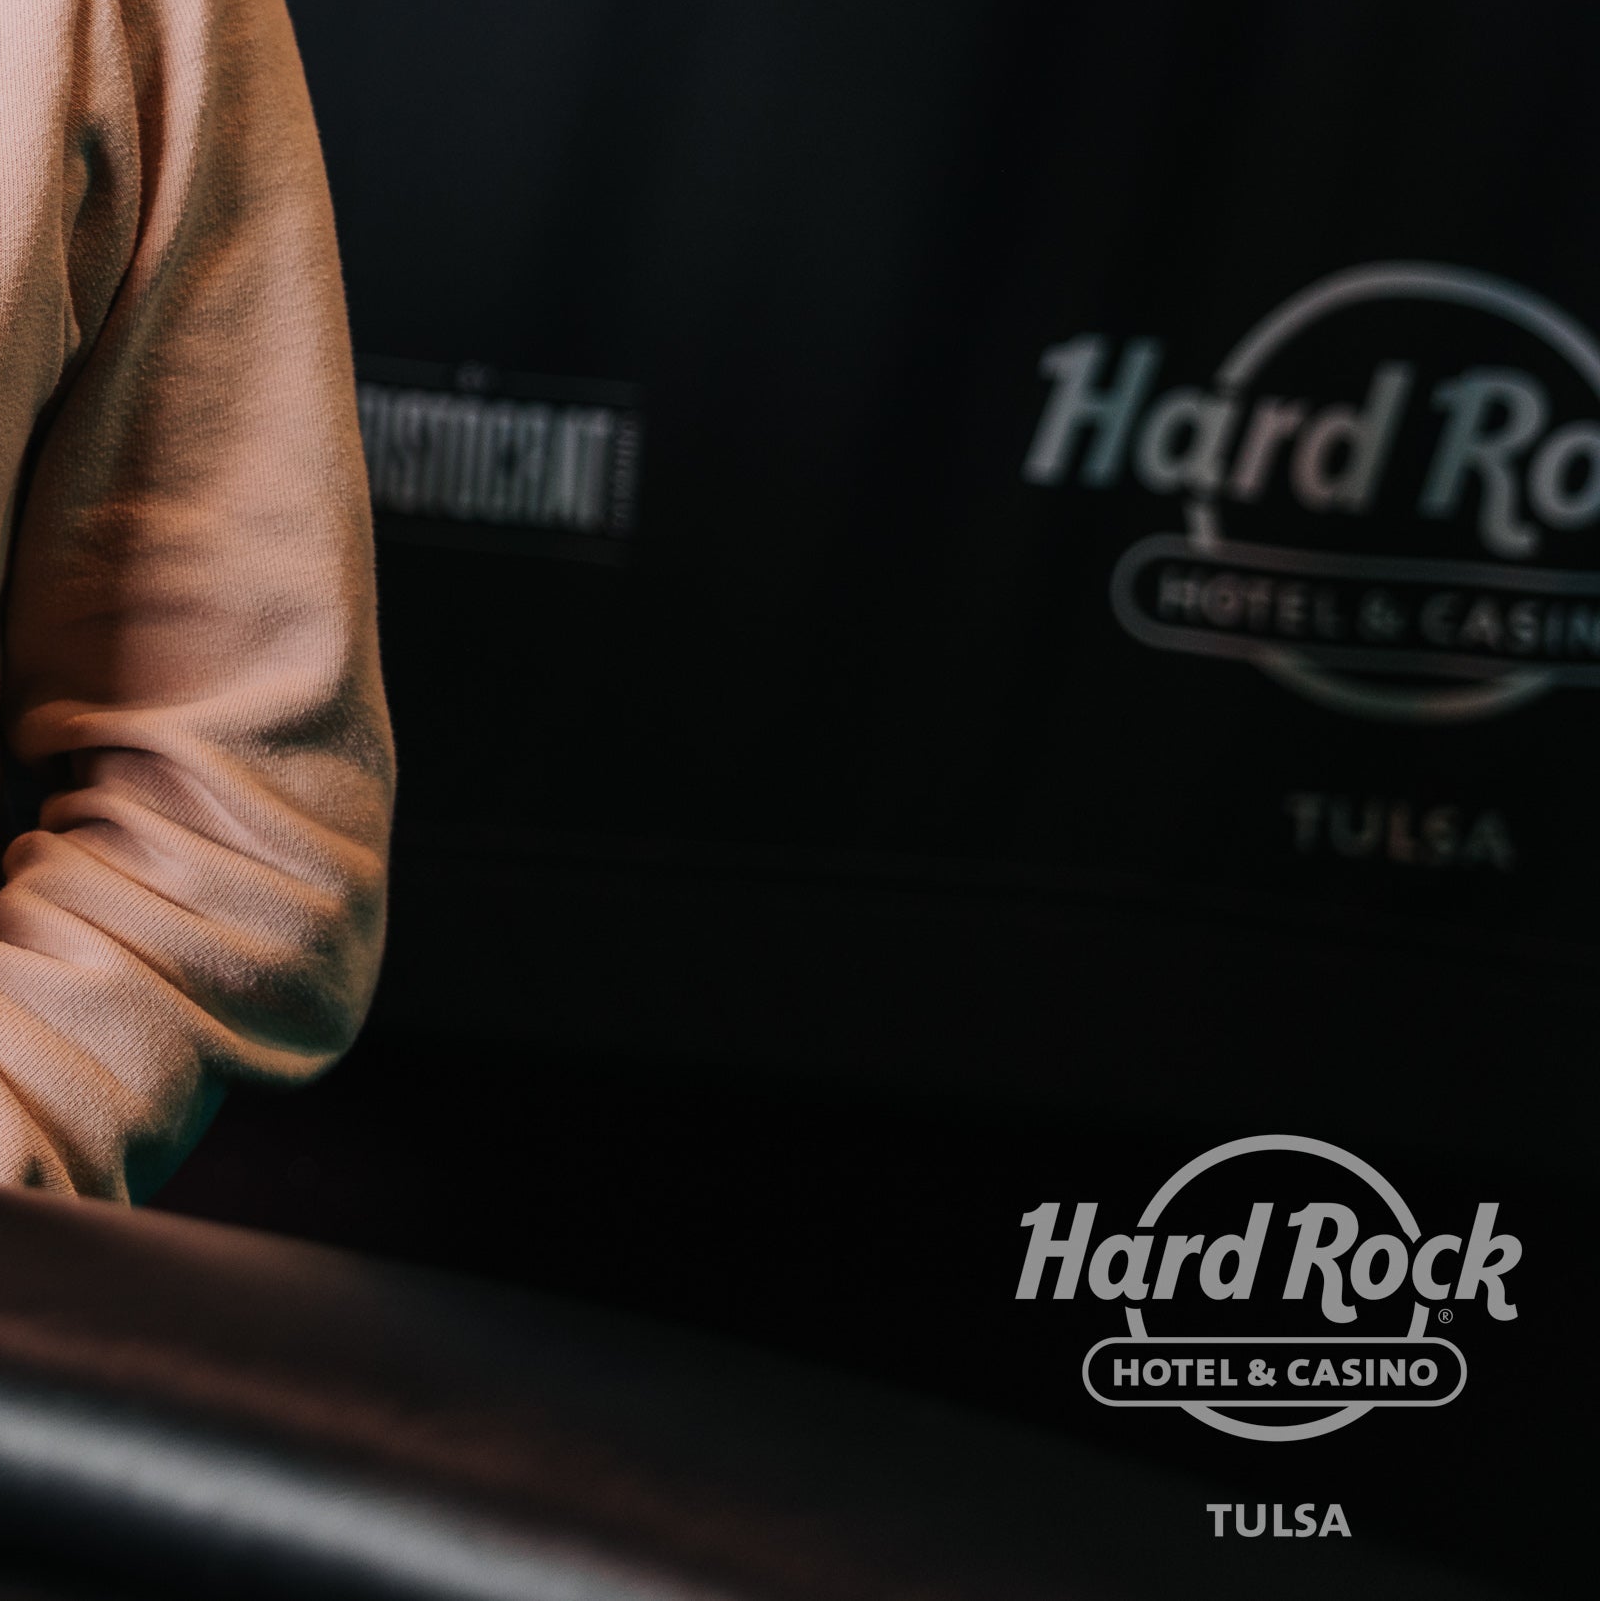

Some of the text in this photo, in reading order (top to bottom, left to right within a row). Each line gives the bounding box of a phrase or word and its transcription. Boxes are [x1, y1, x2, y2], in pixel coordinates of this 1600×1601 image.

[1020, 332, 1600, 559] Hard Ro
[1155, 563, 1342, 641] HOTEL
[1416, 589, 1600, 662] CASIN
[1285, 792, 1518, 871] TULSA
